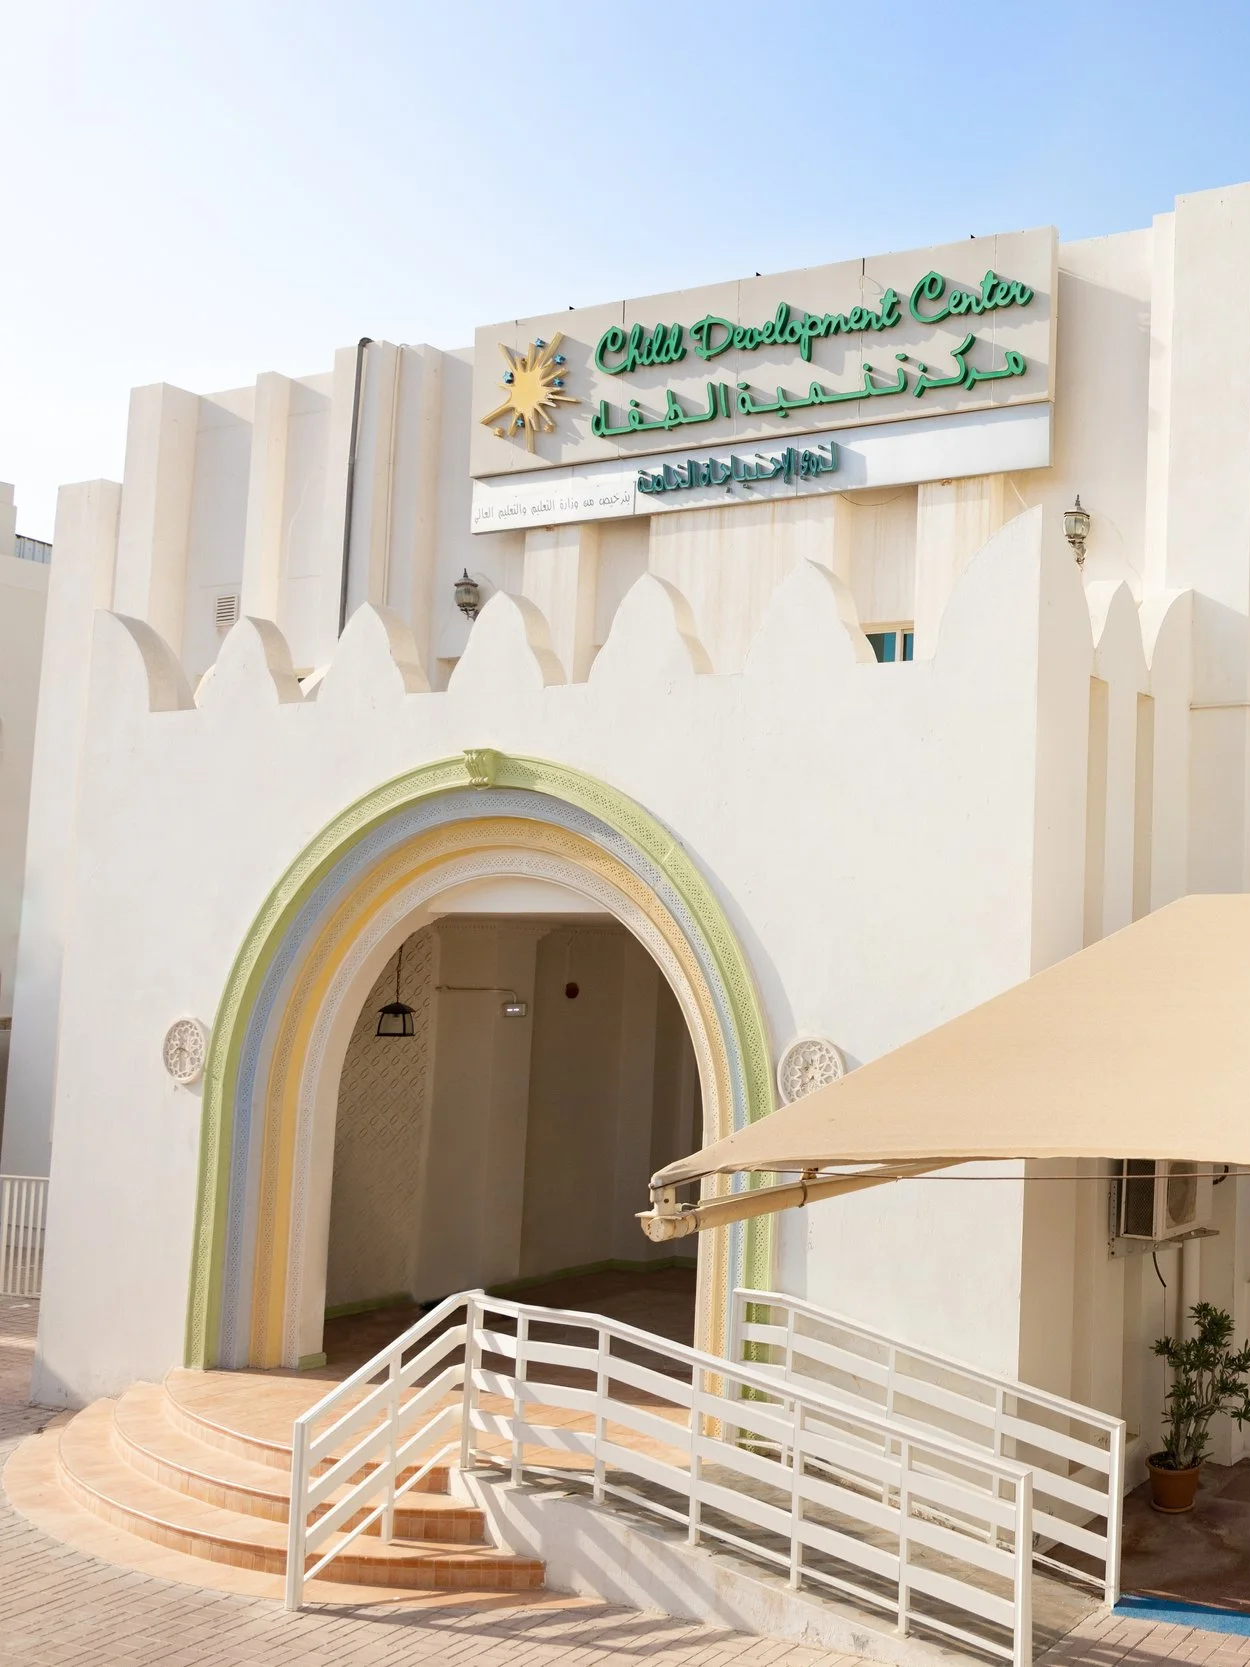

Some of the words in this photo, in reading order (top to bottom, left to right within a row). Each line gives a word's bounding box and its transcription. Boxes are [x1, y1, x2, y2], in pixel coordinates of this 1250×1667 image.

[595, 323, 687, 375] Child
[689, 288, 901, 362] Development
[909, 270, 1034, 324] Center
[913, 333, 1027, 398] مركز
[737, 353, 908, 417] تنمية
[592, 382, 731, 437] الطفل
[637, 459, 699, 494] الخاصة
[498, 503, 528, 520] والتعليم
[530, 498, 556, 516] التعليم
[559, 497, 579, 511] وزارة
[583, 497, 595, 508] من
